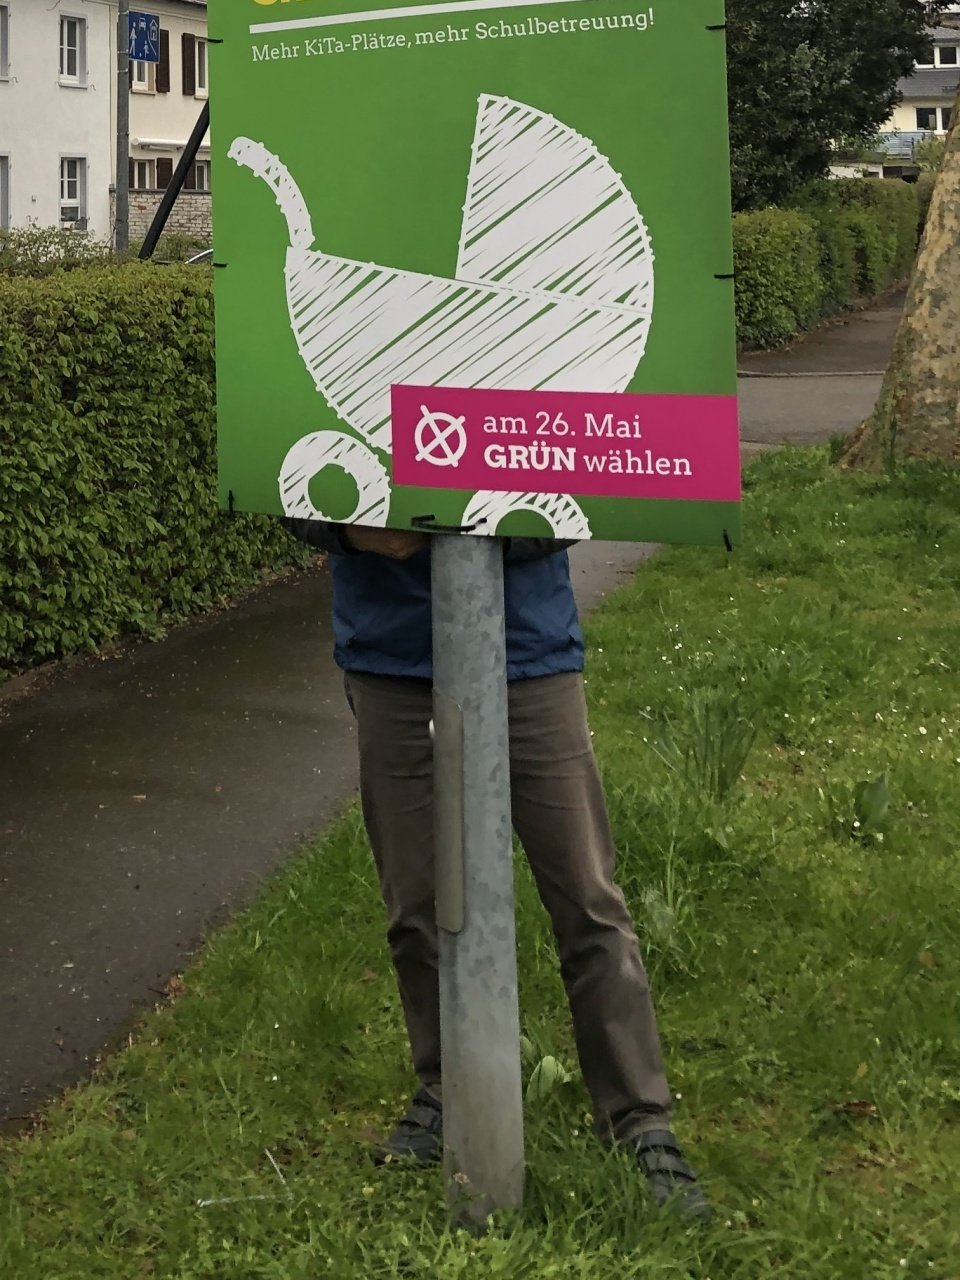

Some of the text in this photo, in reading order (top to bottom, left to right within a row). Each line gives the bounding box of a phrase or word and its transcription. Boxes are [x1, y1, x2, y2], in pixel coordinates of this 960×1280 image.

[251, 8, 655, 61] Mehr KiTa-Plätze, mehr Schulbetreuung!
[483, 411, 642, 438] am 26. Mai
[484, 440, 692, 476] GRÜN wählen
